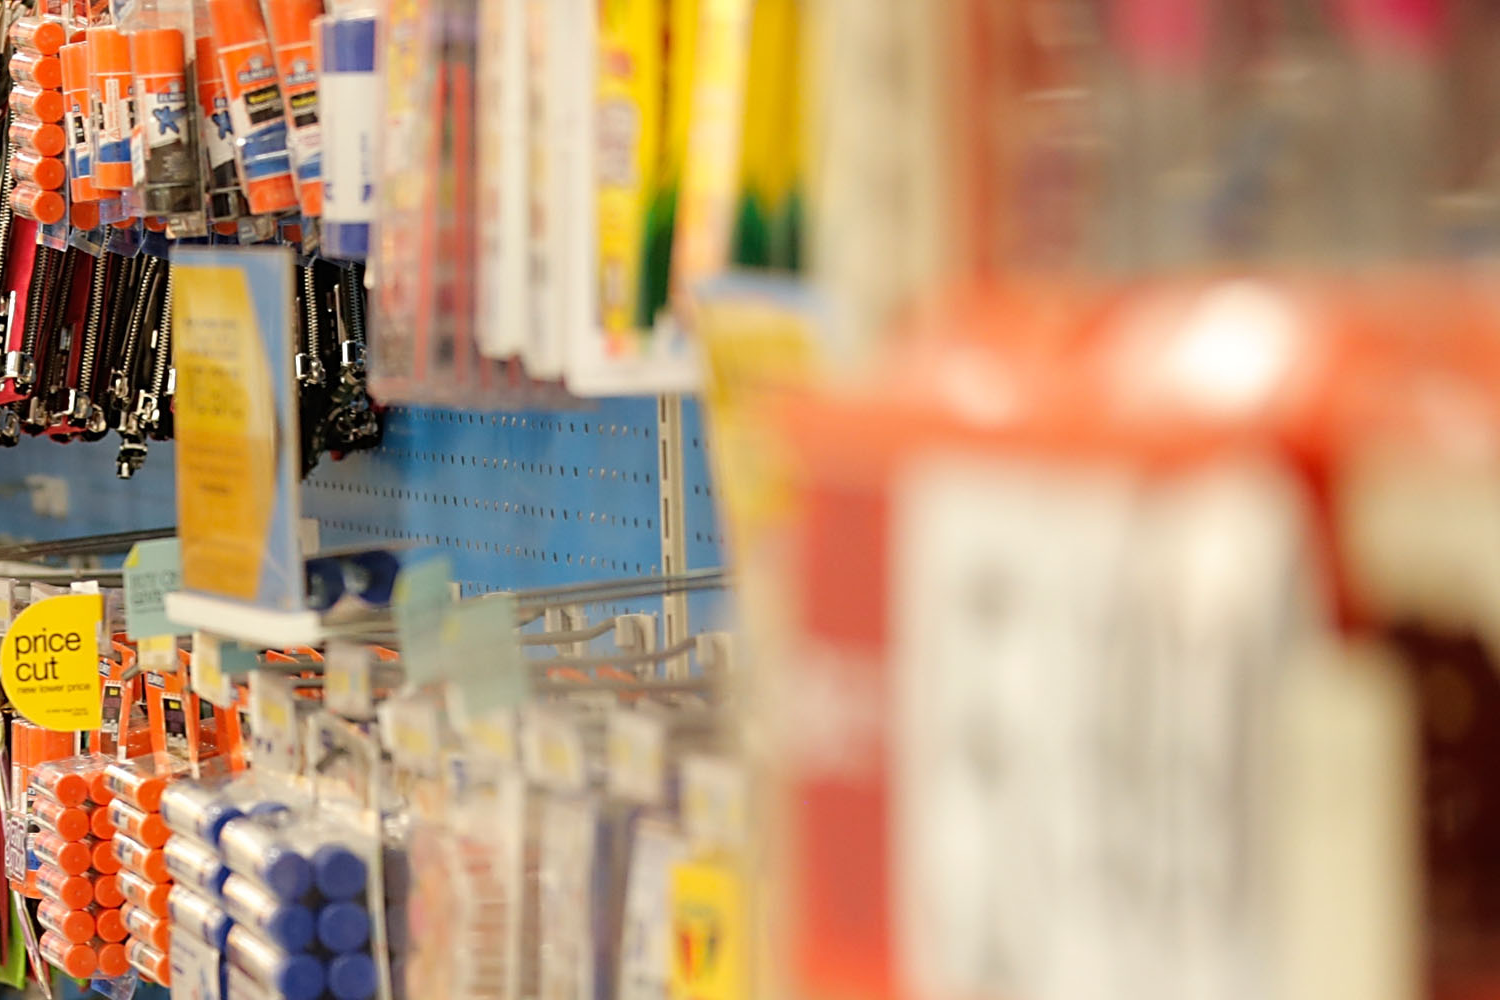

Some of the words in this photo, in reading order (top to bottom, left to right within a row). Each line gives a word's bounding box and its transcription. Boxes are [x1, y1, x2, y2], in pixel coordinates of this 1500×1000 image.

[15, 627, 81, 660] price
[16, 656, 59, 682] cut
[16, 686, 37, 694] new
[40, 685, 64, 693] lower
[67, 683, 91, 693] price
